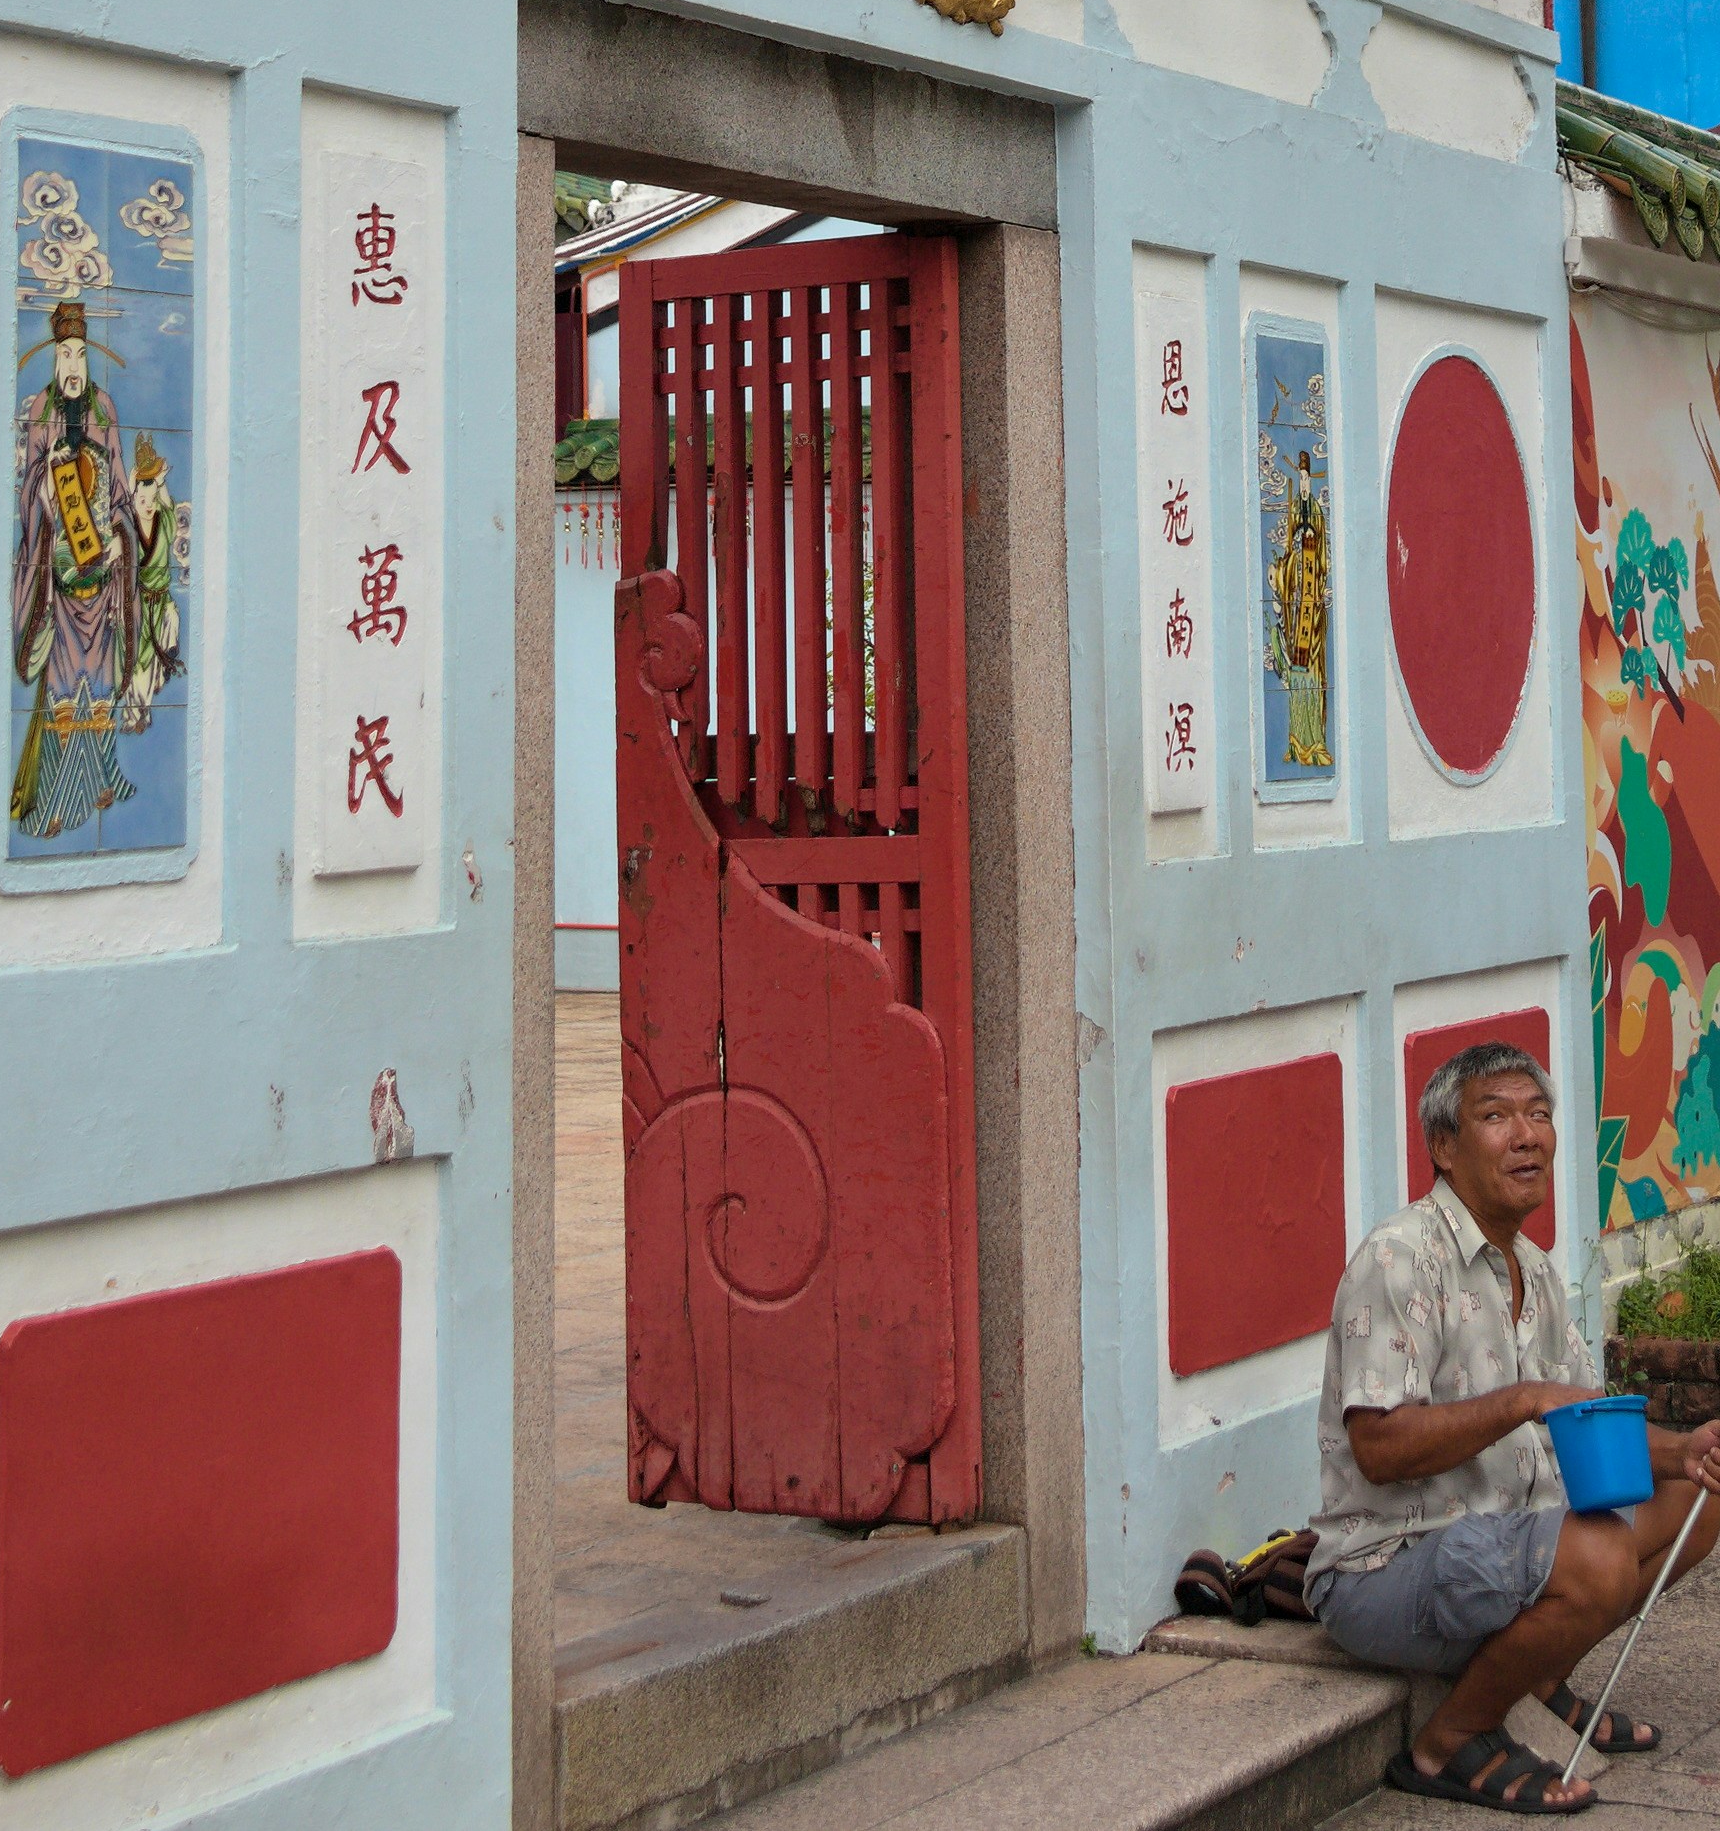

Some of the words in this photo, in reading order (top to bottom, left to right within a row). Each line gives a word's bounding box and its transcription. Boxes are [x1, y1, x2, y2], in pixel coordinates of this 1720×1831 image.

[346, 202, 410, 819] 惠及萬民
[1159, 339, 1196, 773] 恩施南溟
